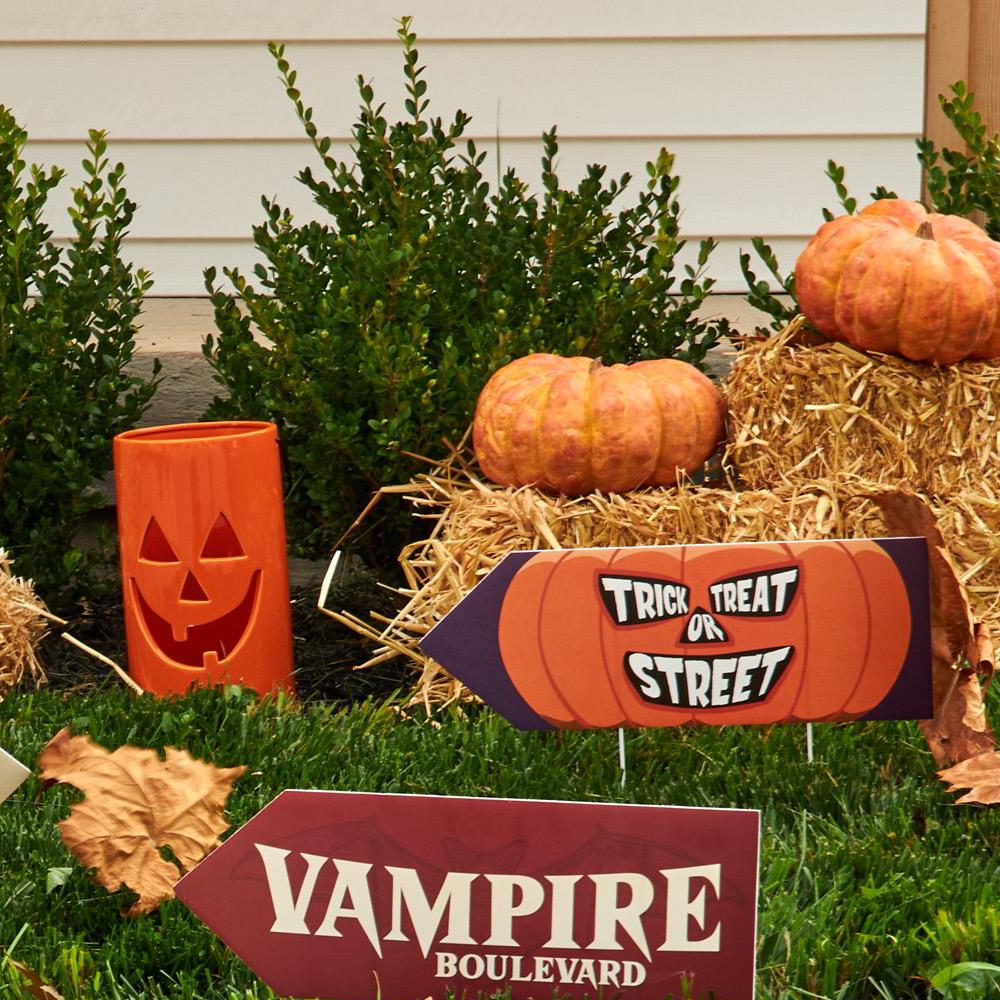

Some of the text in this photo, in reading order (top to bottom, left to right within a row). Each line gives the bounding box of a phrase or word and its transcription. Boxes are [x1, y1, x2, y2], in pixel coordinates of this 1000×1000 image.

[601, 568, 798, 643] TRICK OR TREAT
[628, 646, 792, 708] STREET
[254, 843, 721, 962] VAMPIRE
[435, 951, 646, 990] BOULEVARD
